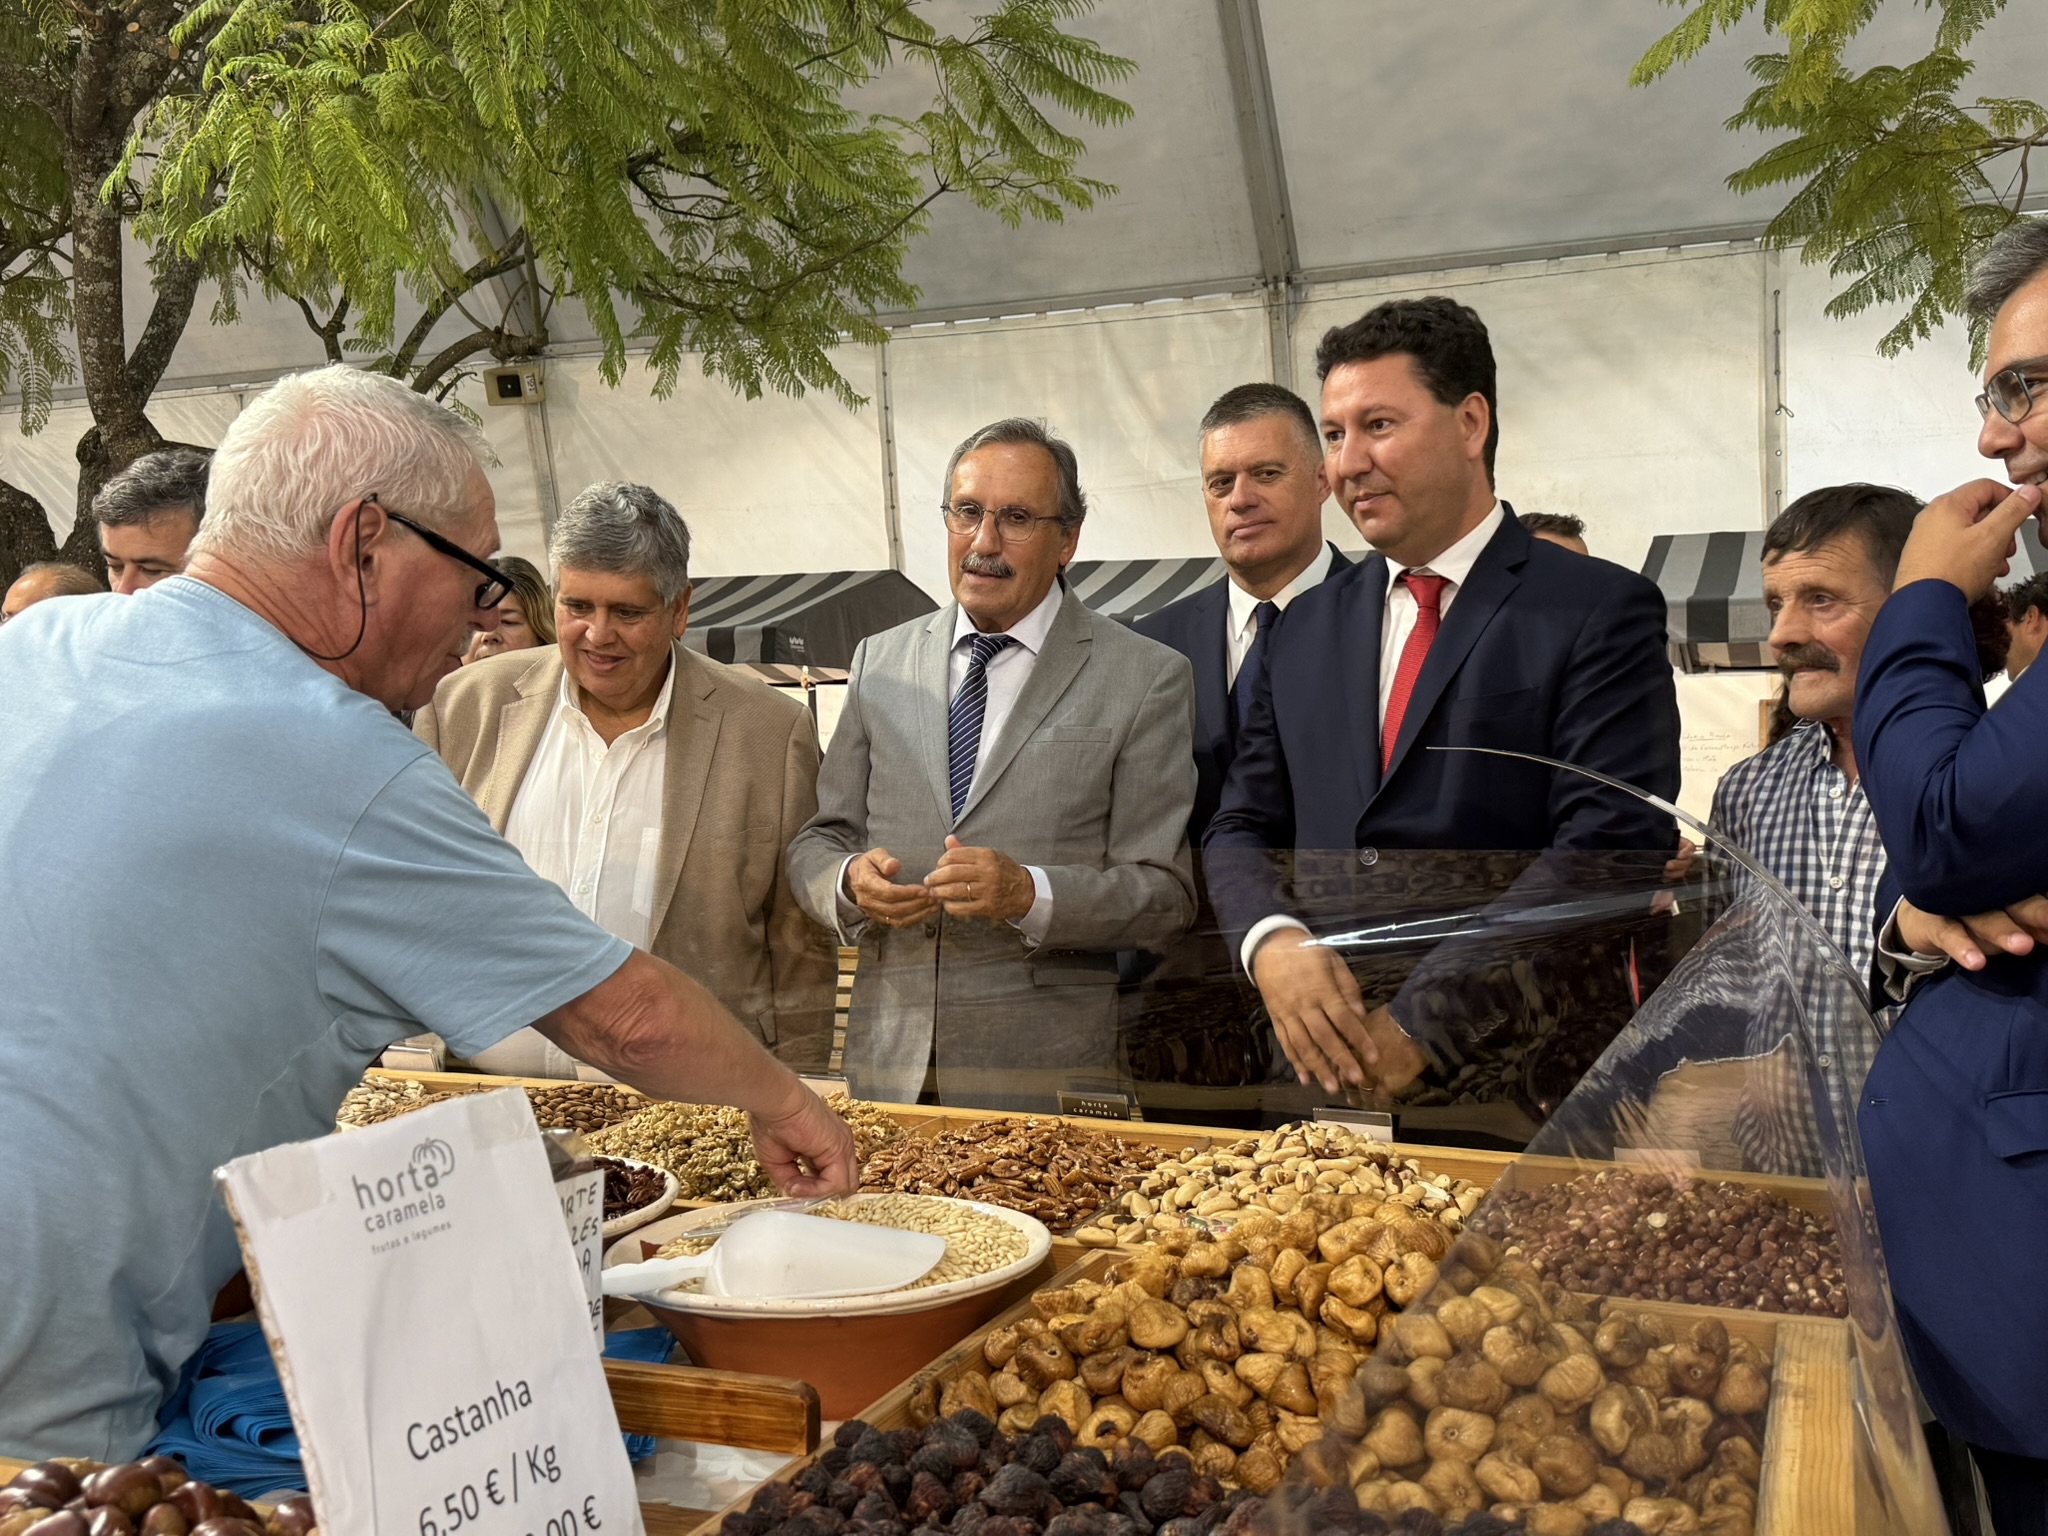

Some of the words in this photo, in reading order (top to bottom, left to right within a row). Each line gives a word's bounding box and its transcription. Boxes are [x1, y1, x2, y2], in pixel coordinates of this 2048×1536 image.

[1073, 1107, 1118, 1117] caramela
[1081, 1100, 1108, 1109] horta
[351, 1161, 440, 1210] horta
[364, 1191, 446, 1233] caramela
[406, 1379, 533, 1461] Castanha
[419, 1484, 479, 1536] 6,50
[485, 1468, 505, 1506] €
[512, 1451, 519, 1504] /
[525, 1444, 562, 1484] Kg
[583, 1494, 602, 1530] €
